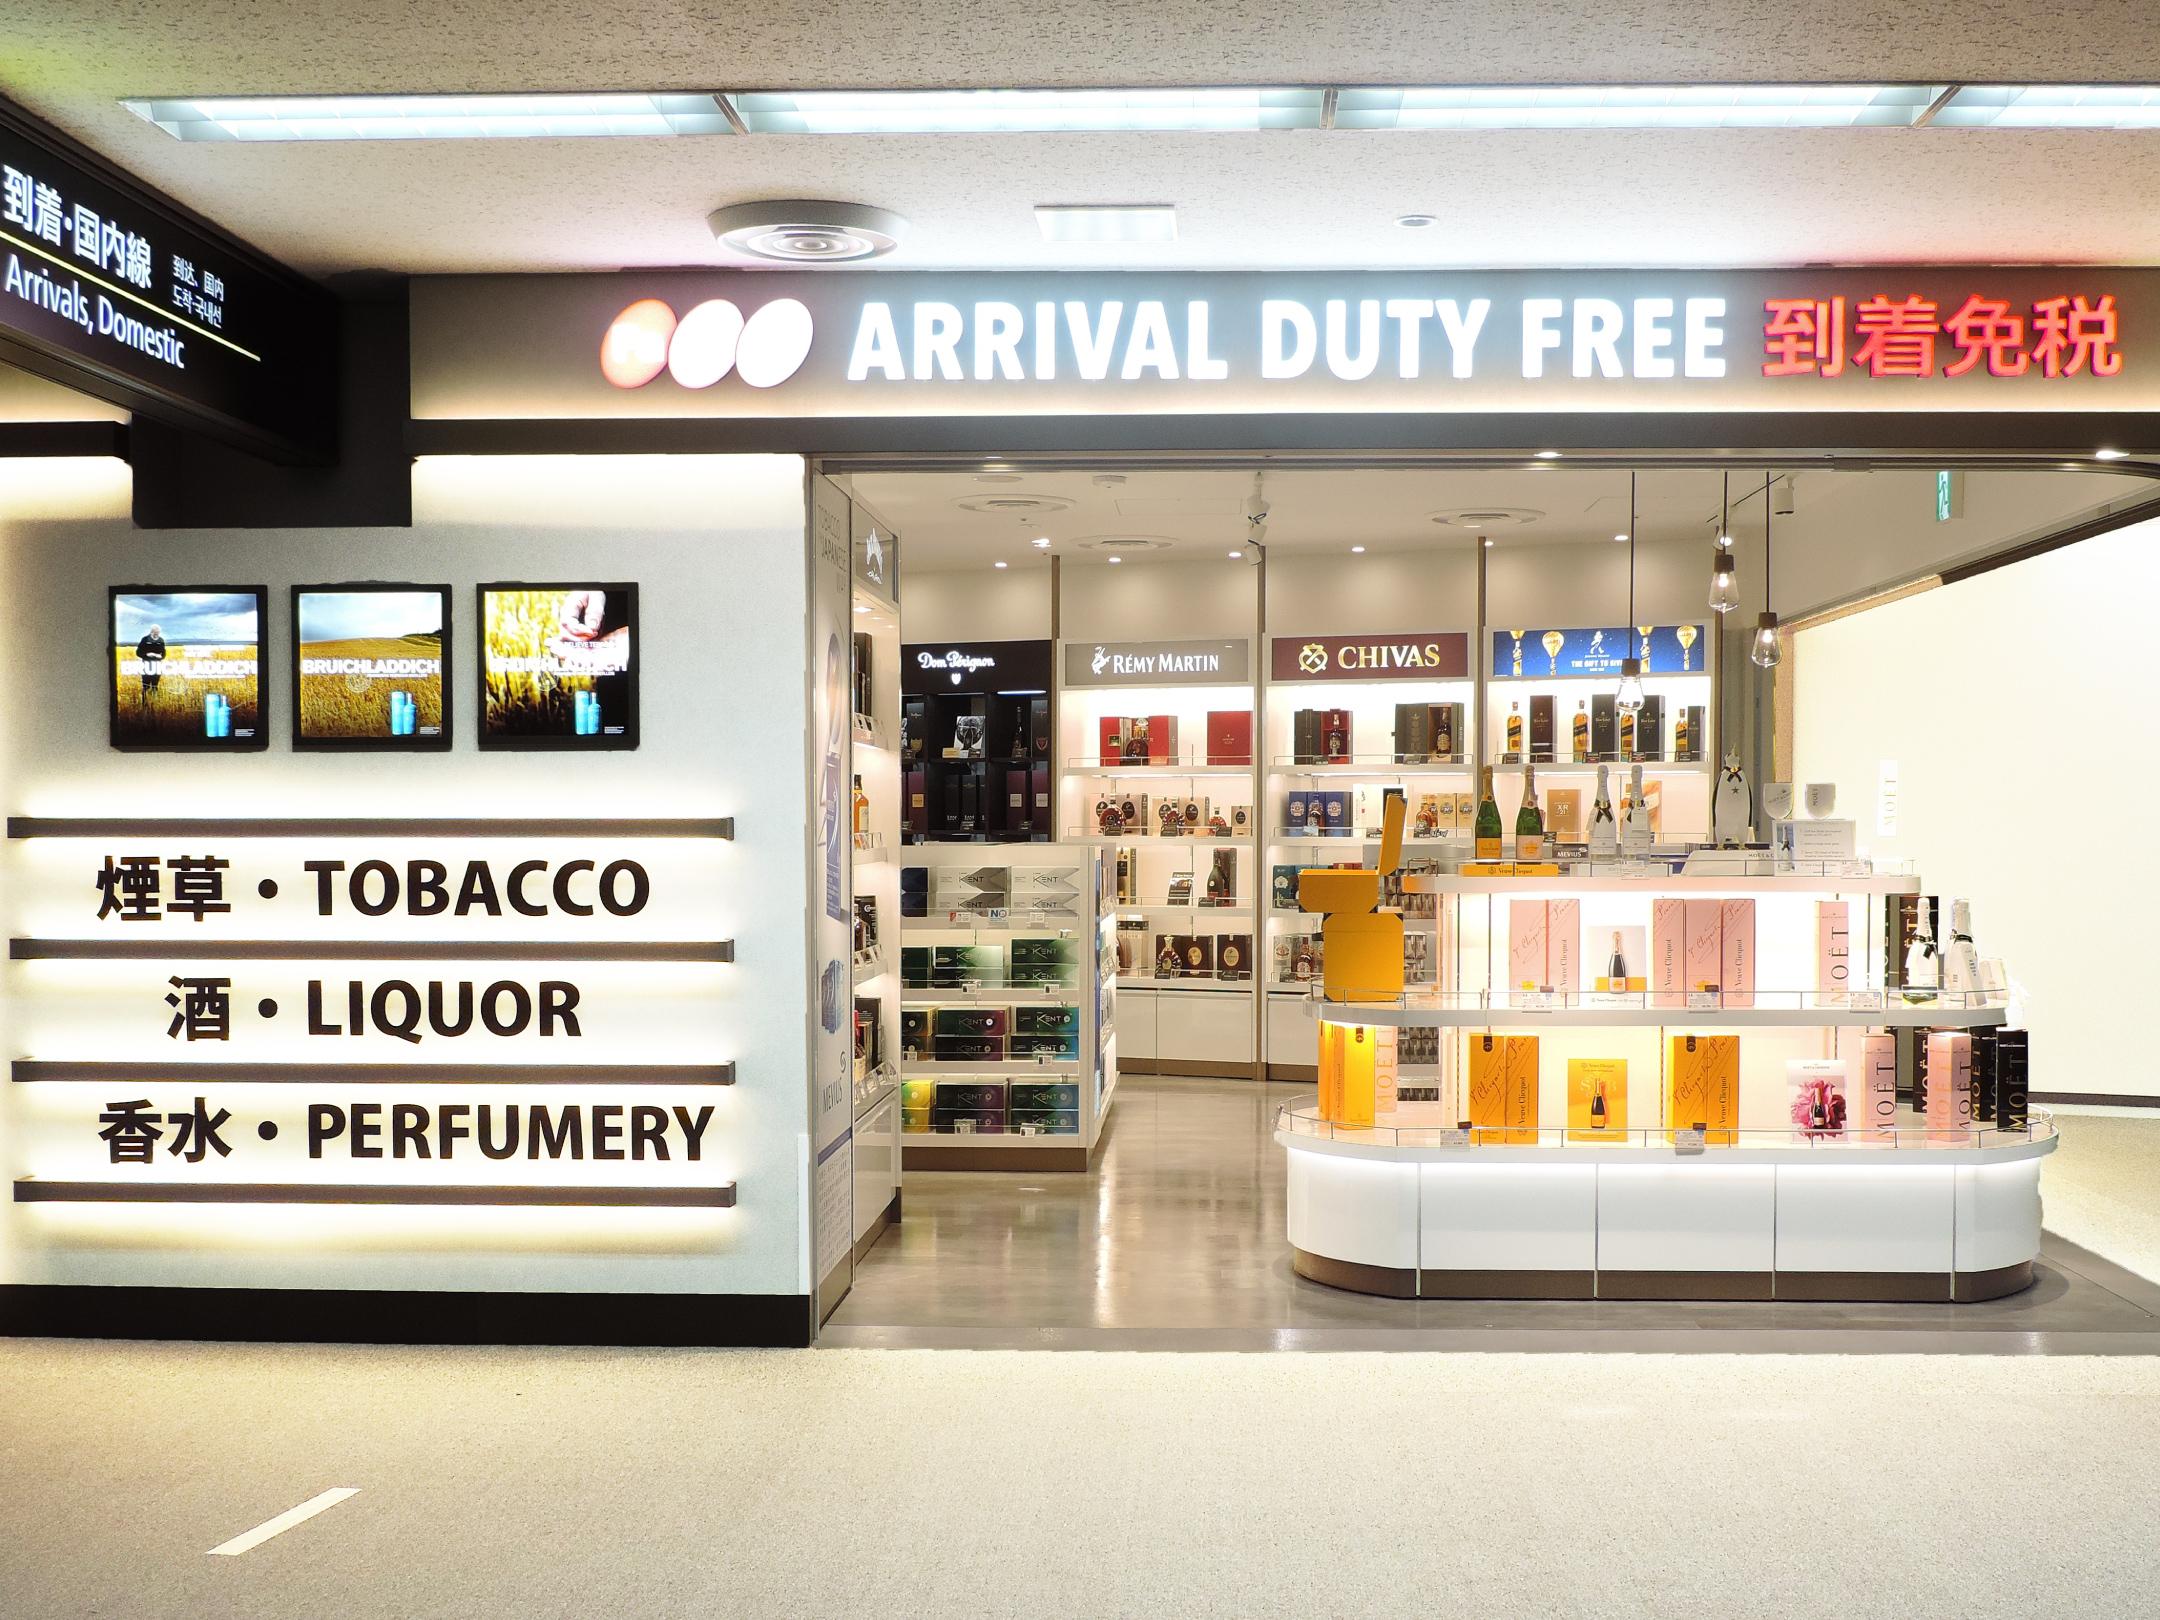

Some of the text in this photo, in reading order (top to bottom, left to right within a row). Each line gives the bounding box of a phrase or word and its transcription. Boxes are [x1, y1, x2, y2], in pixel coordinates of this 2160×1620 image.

[5, 253, 185, 369] Arrivals, Domestic
[847, 294, 2123, 381] ARRIVAL DUTY FREE 到着免税
[302, 659, 441, 674] BRUICHLADDICH
[917, 651, 996, 673] Dom Pérignon
[1113, 653, 1219, 674] RÉMY MARTIN
[1337, 644, 1441, 669] CHIVAS
[96, 855, 650, 922] 煙草 TOBACCO
[1032, 899, 1058, 909] KENT
[1033, 875, 1059, 886] KENT
[1829, 927, 1848, 1003] MOËT
[164, 976, 582, 1044] 酒 LIQUOR
[1037, 1014, 1061, 1026] KENT
[1518, 1076, 1527, 1105] Clicquot
[1873, 1062, 1895, 1138] MOËT
[2006, 1055, 2027, 1131] MOËT
[98, 1097, 715, 1164] 香水 PERFUMERY
